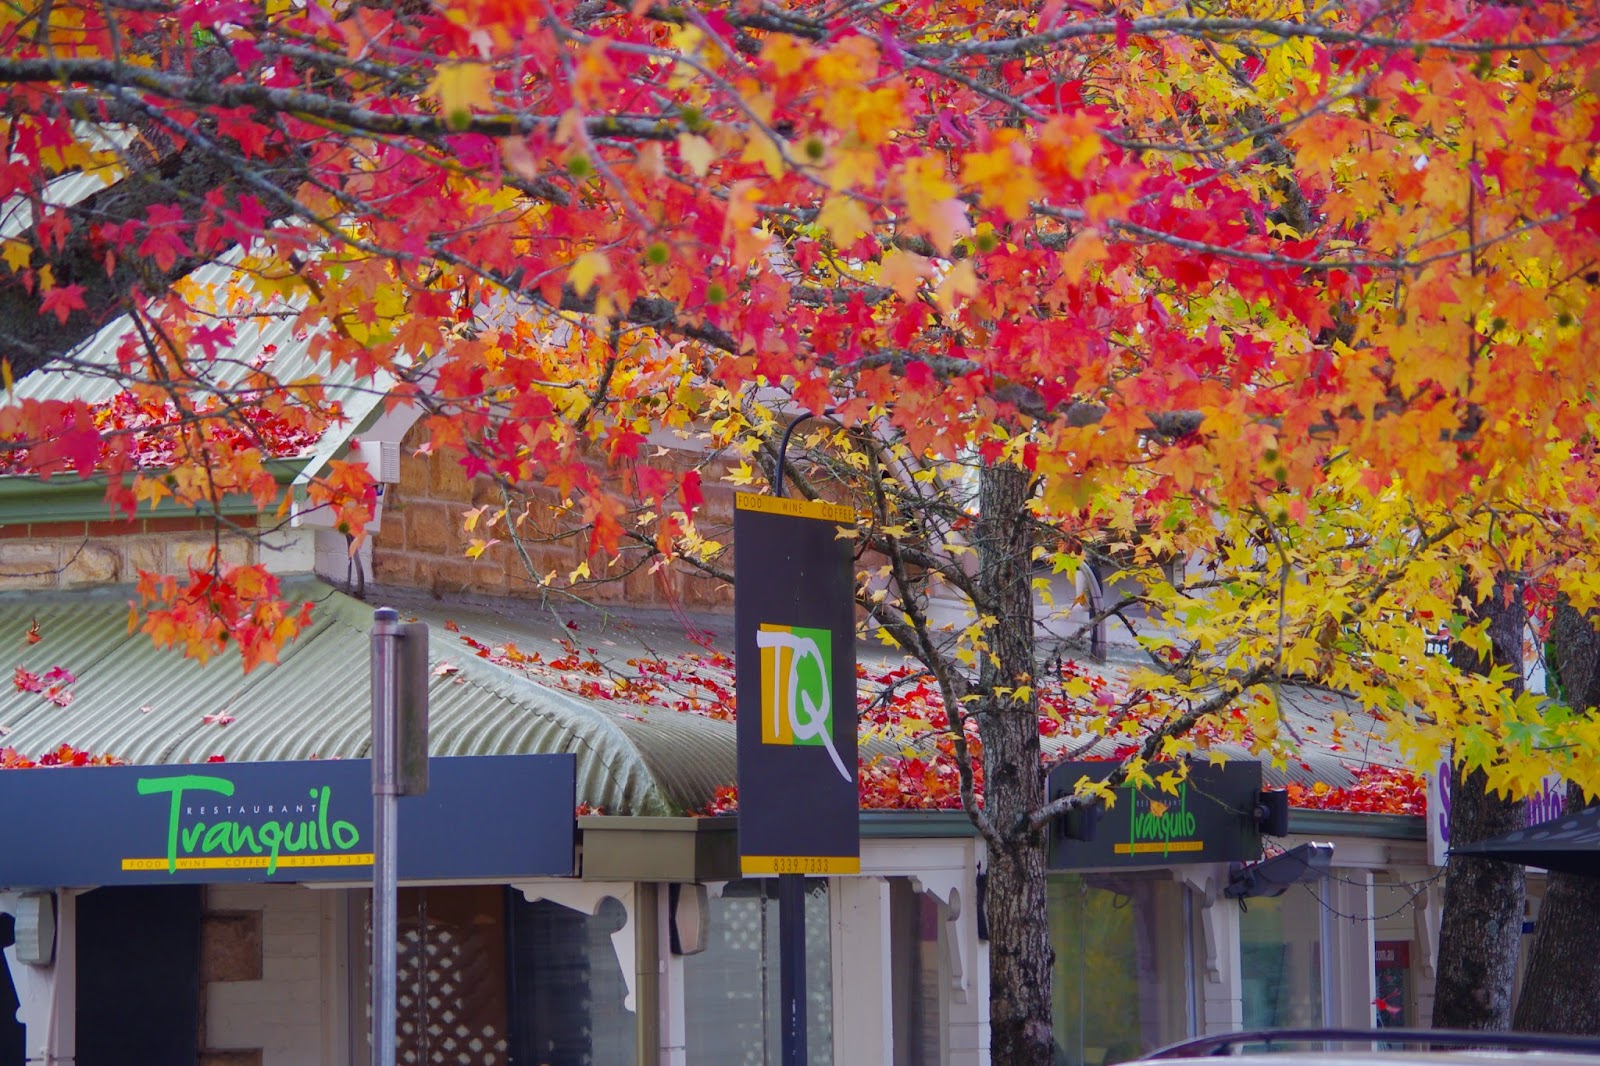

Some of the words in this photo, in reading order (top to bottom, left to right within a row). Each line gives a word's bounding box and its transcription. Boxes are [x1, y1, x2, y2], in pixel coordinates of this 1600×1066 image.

[738, 495, 762, 509] FOOD
[781, 501, 803, 514] WINE
[821, 506, 852, 521] COFFEE
[1424, 642, 1448, 655] RDS
[756, 629, 853, 783] TQ
[186, 804, 317, 815] RESTAURANT
[137, 775, 360, 876] Tranquilo
[129, 859, 162, 869] FOOD
[180, 858, 208, 868] WINE
[225, 857, 267, 867] COFFEE
[290, 856, 327, 866] 8339
[336, 854, 372, 865] 7333
[773, 858, 799, 872] 8339
